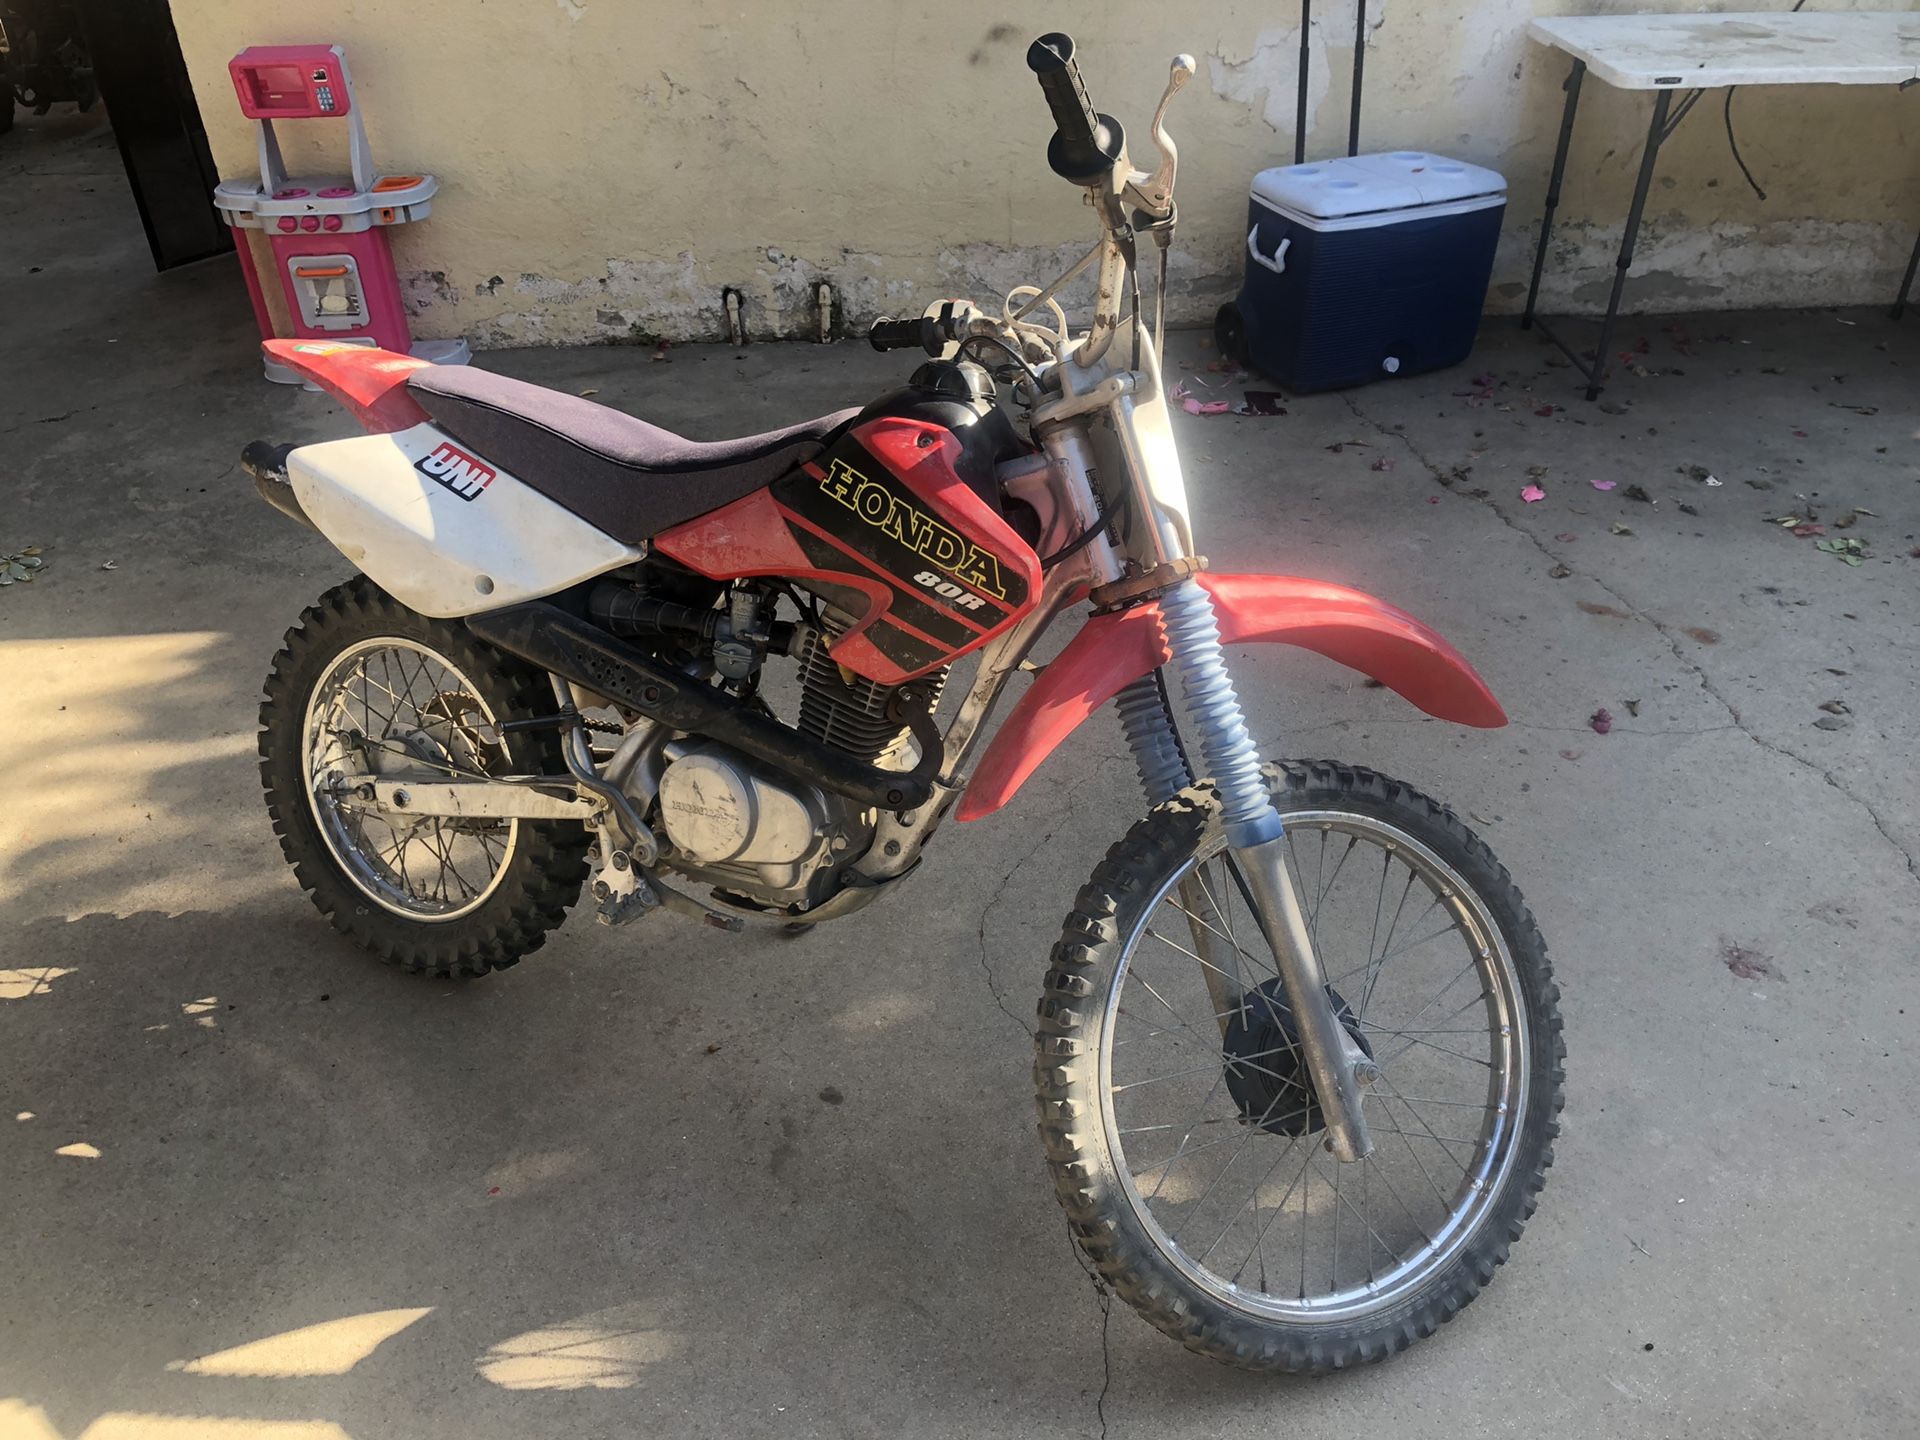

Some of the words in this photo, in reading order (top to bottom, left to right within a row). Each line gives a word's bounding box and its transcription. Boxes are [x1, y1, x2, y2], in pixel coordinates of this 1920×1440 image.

[420, 447, 492, 498] UNI
[819, 457, 1007, 600] HONDA
[912, 570, 987, 611] 80R
